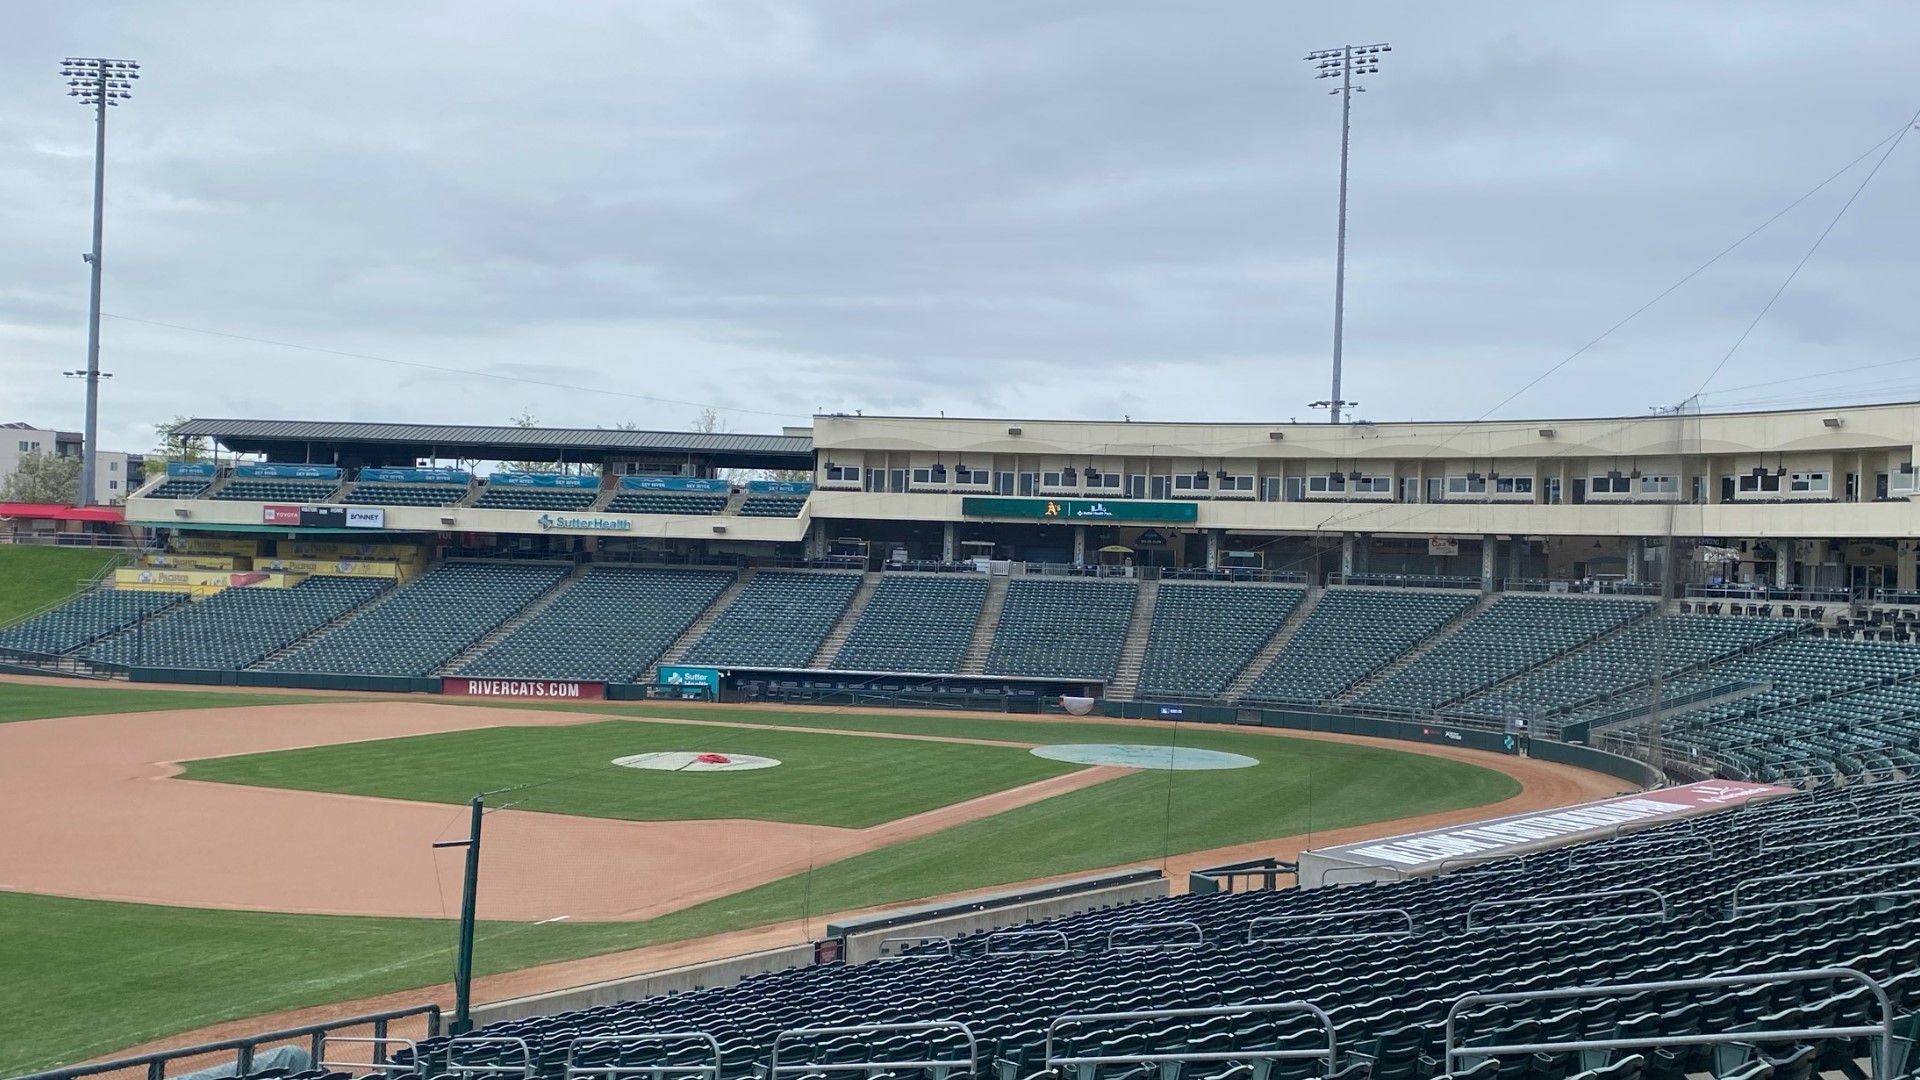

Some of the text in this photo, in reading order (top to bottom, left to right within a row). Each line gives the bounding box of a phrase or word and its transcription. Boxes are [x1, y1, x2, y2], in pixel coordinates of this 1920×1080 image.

[350, 513, 379, 521] BONNEY
[684, 672, 708, 681] Sutter
[468, 680, 579, 697] RIVERCATS.COM
